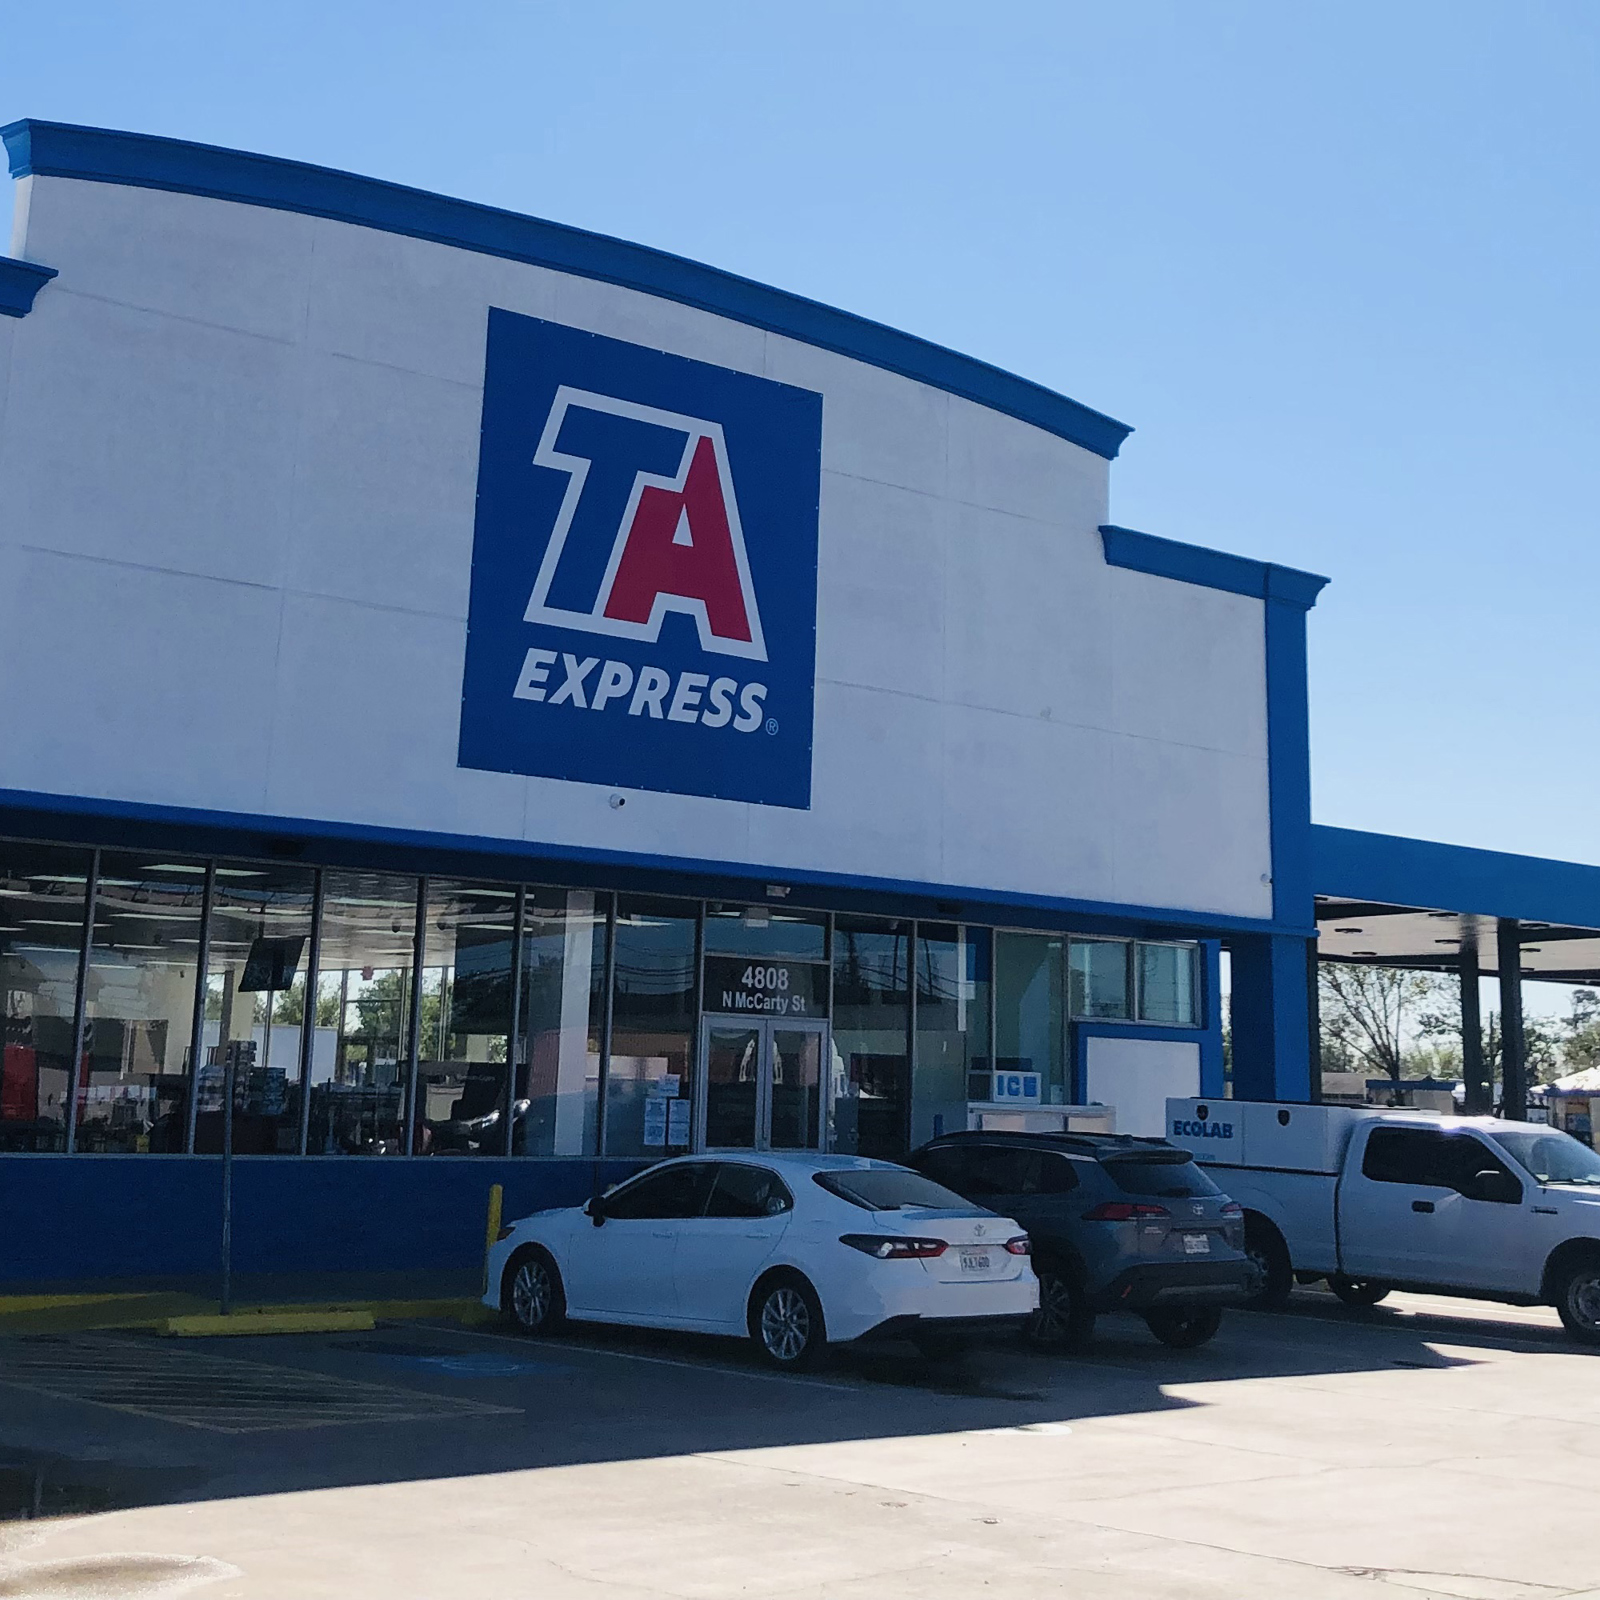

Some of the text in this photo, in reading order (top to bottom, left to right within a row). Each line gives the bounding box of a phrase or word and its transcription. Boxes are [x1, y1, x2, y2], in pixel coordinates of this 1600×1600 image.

[523, 384, 769, 662] TA
[512, 647, 768, 732] EXPRESS
[741, 965, 789, 990] 4808
[722, 990, 806, 1015] N McCarty St
[997, 1074, 1038, 1097] ICE
[1173, 1119, 1234, 1139] ECOLAB
